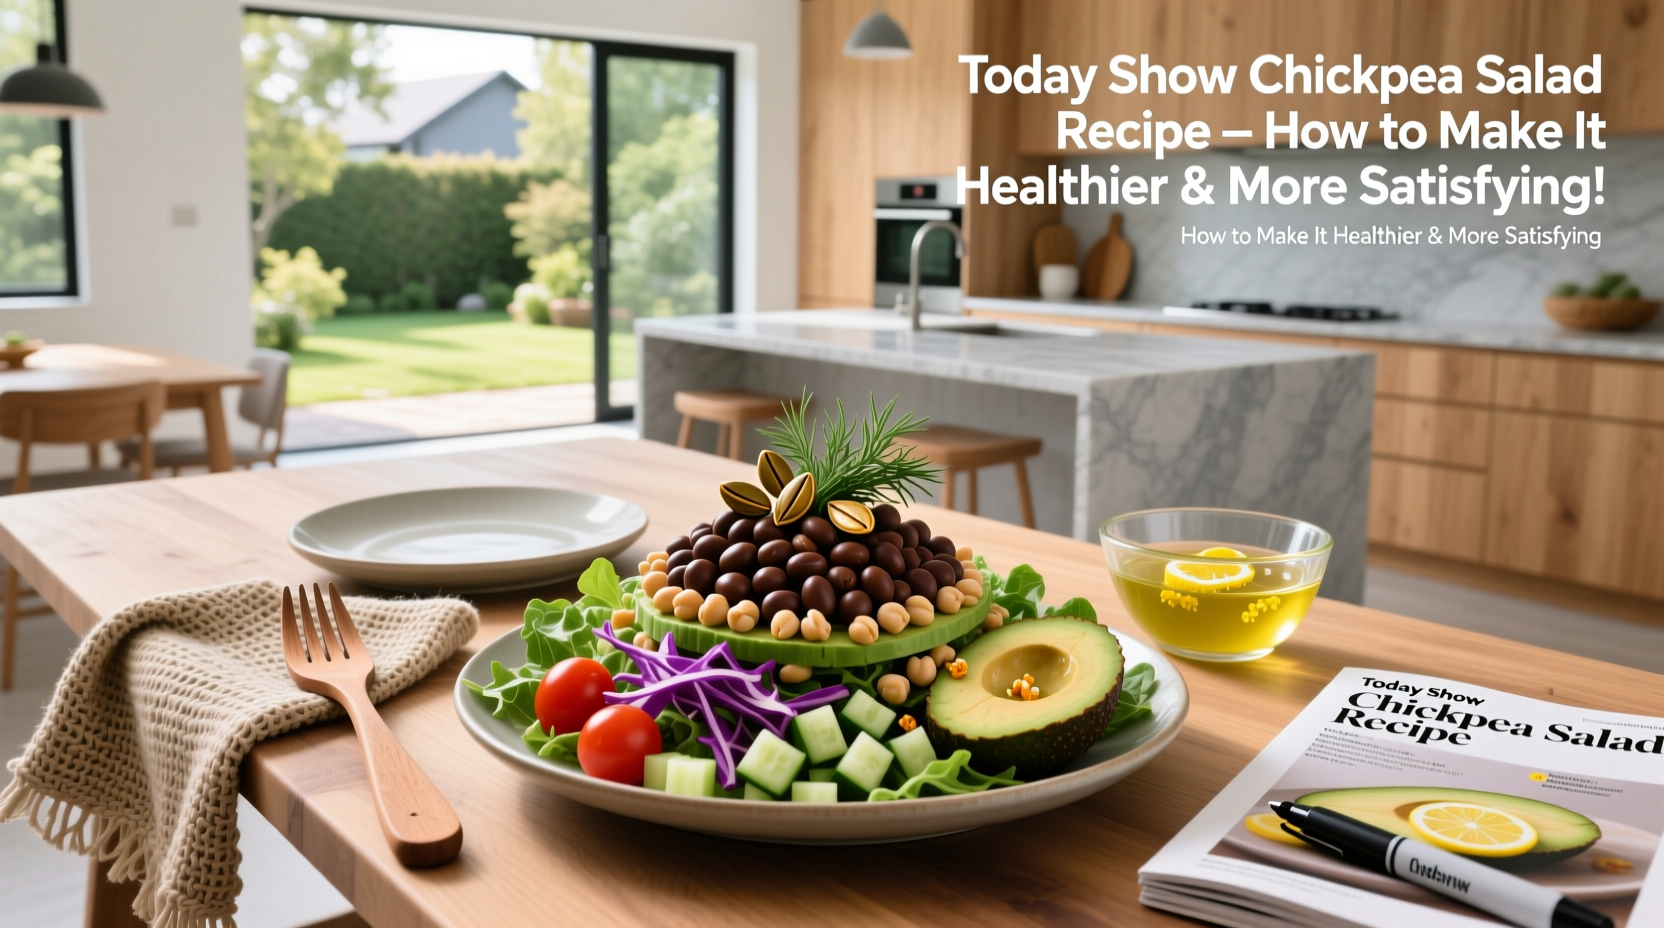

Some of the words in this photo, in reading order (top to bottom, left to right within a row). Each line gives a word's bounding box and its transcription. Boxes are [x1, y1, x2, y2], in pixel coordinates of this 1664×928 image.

[1362, 676, 1424, 697] Today
[1426, 687, 1486, 707] Show
[1330, 707, 1472, 746] Recipe
[1348, 691, 1534, 738] Chickpea
[1543, 723, 1664, 755] Salad
